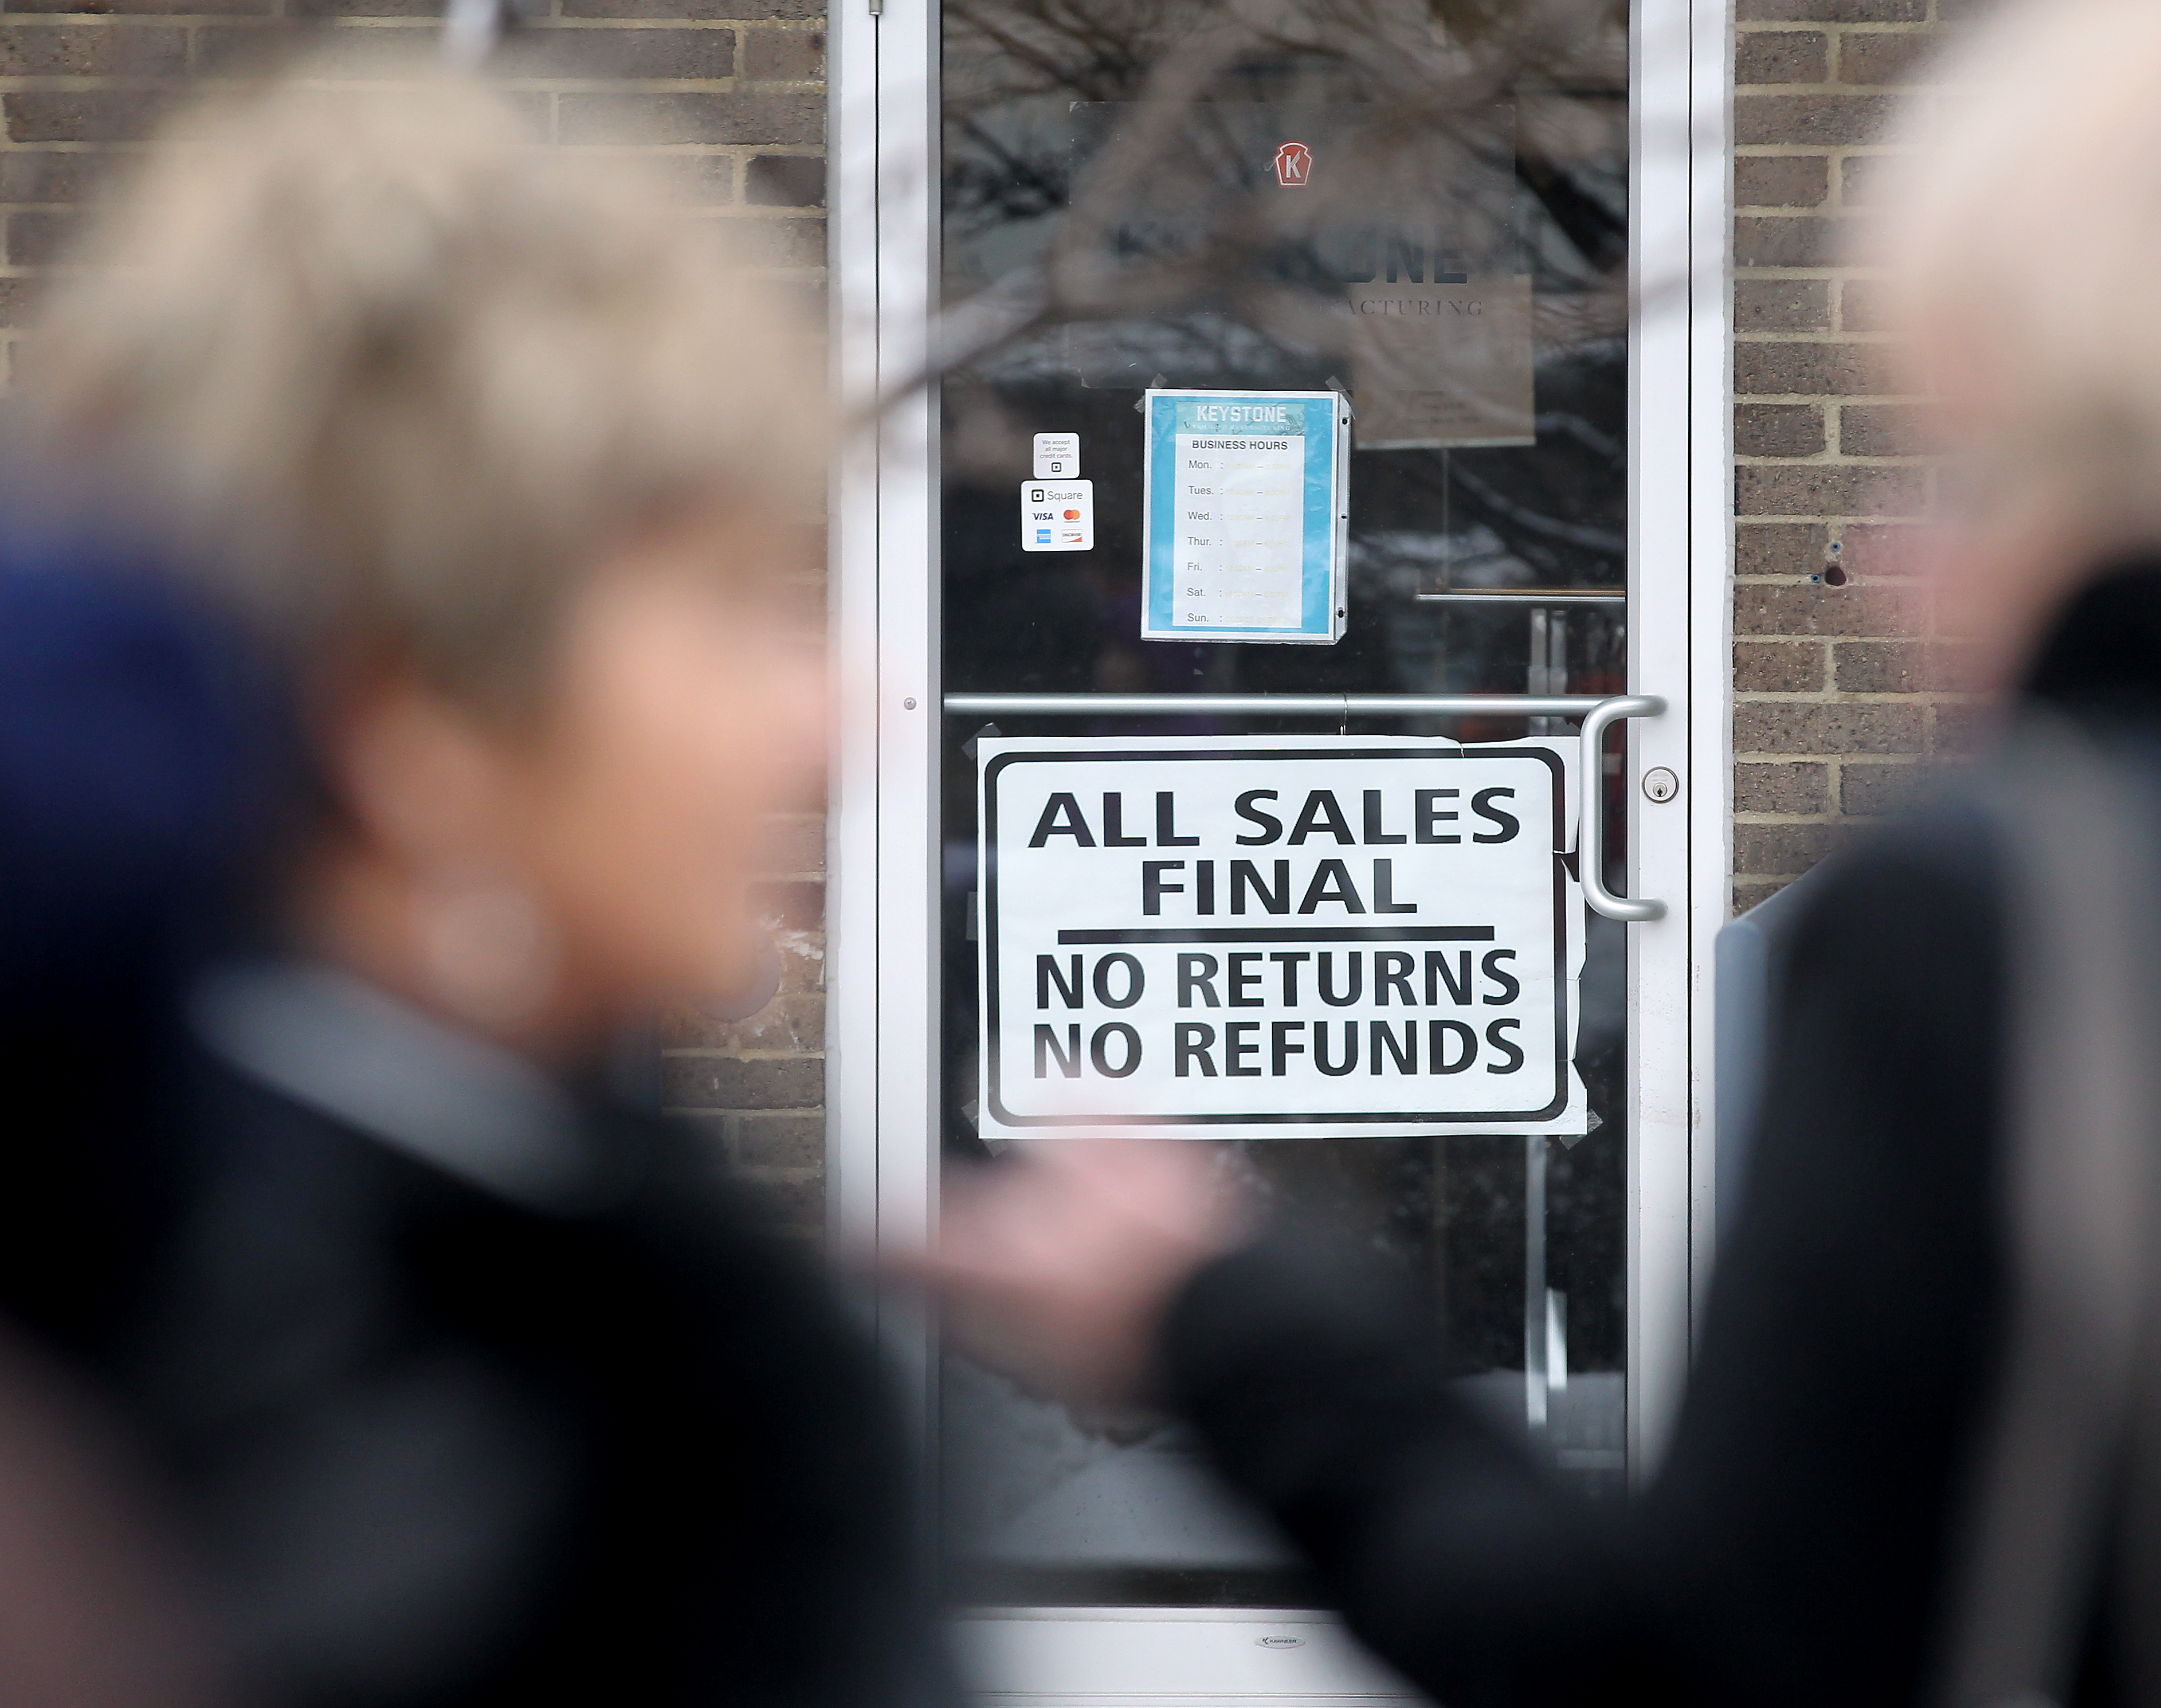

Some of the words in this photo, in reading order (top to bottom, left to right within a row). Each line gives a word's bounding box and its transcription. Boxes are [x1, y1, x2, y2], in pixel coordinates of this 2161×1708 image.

[1197, 405, 1287, 422] KEYSTONE
[1192, 440, 1246, 449] BUSINESS
[1250, 441, 1288, 450] HOURS
[1189, 460, 1211, 469] Mon.
[1188, 485, 1214, 495] Tues.
[1048, 491, 1083, 502] Square
[1187, 511, 1212, 520] Wed.
[1187, 537, 1211, 546] Thur.
[1187, 562, 1202, 571] Fri.
[1187, 587, 1206, 597] Sat.
[1187, 613, 1209, 622] Sun.
[1028, 792, 1199, 848] ALL
[1234, 788, 1519, 845] SALES
[1143, 859, 1417, 915] FINAL
[1036, 953, 1145, 1009] NO
[1178, 950, 1519, 1007] RETURNS
[1034, 1023, 1142, 1078] NO
[1175, 1018, 1524, 1076] REFUNDS
